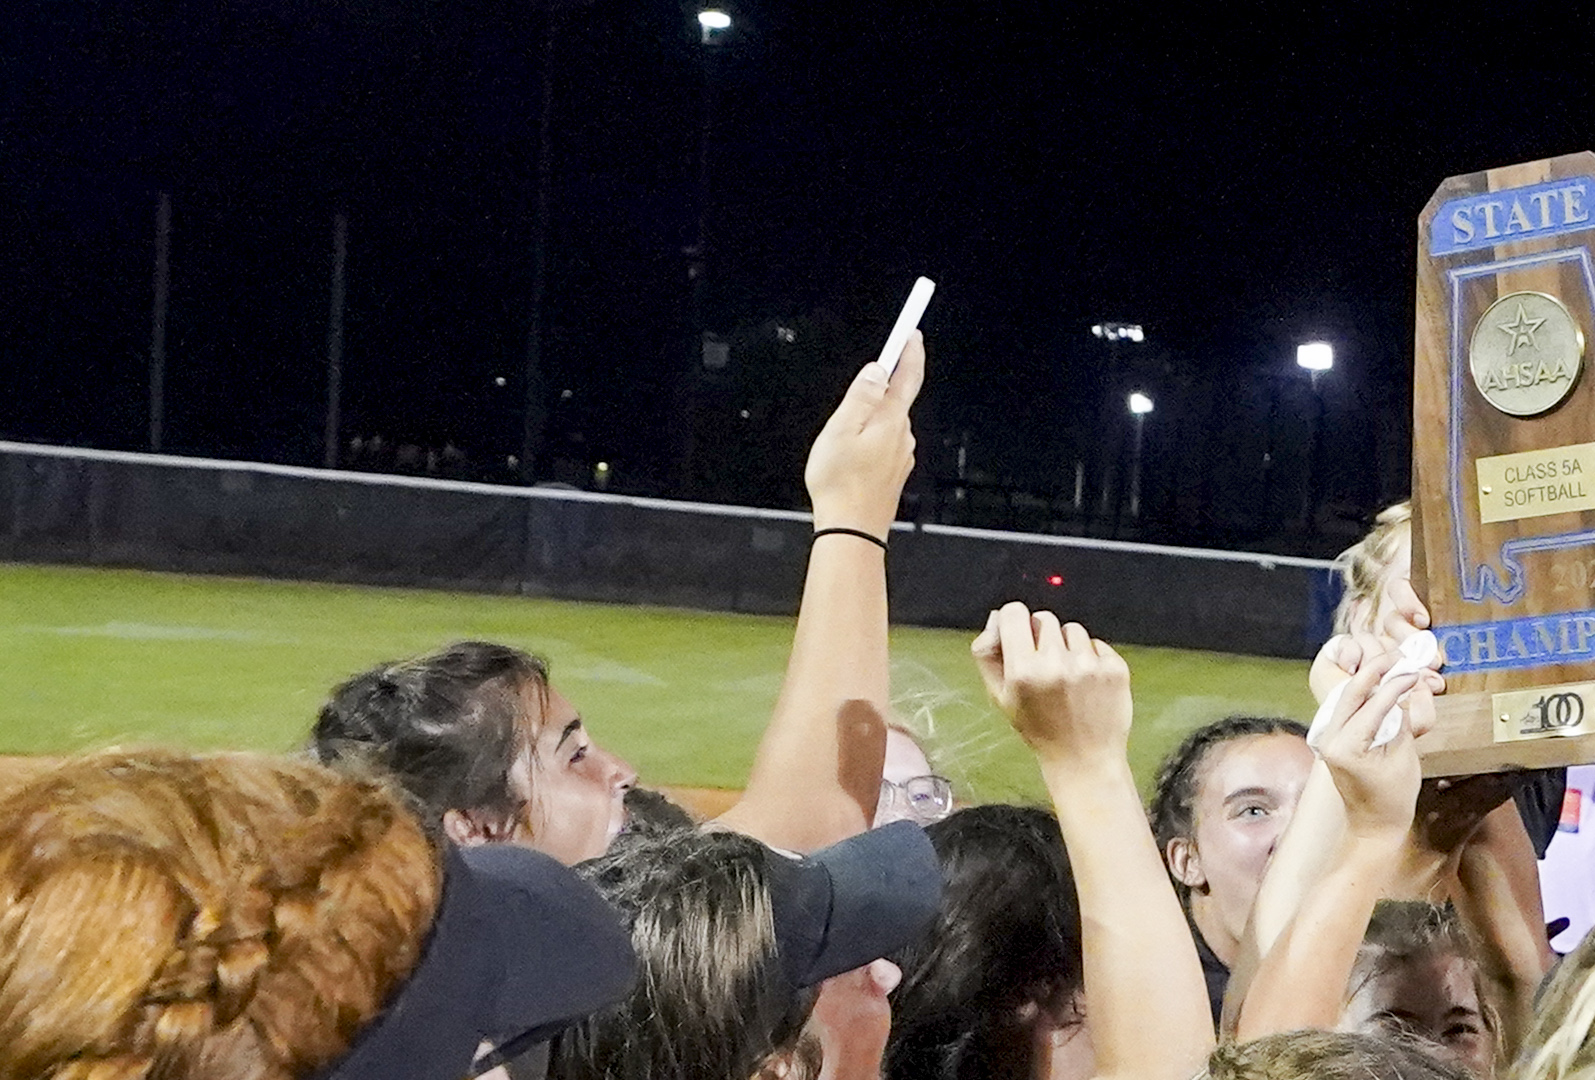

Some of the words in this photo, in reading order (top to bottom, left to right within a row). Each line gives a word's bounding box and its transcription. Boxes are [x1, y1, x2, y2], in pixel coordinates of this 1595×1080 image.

[1452, 185, 1589, 243] STATE
[1483, 358, 1572, 392] AHSAA
[1504, 461, 1558, 483] CLASS
[1561, 459, 1583, 476] 5A
[1504, 482, 1587, 508] SOFTBALL
